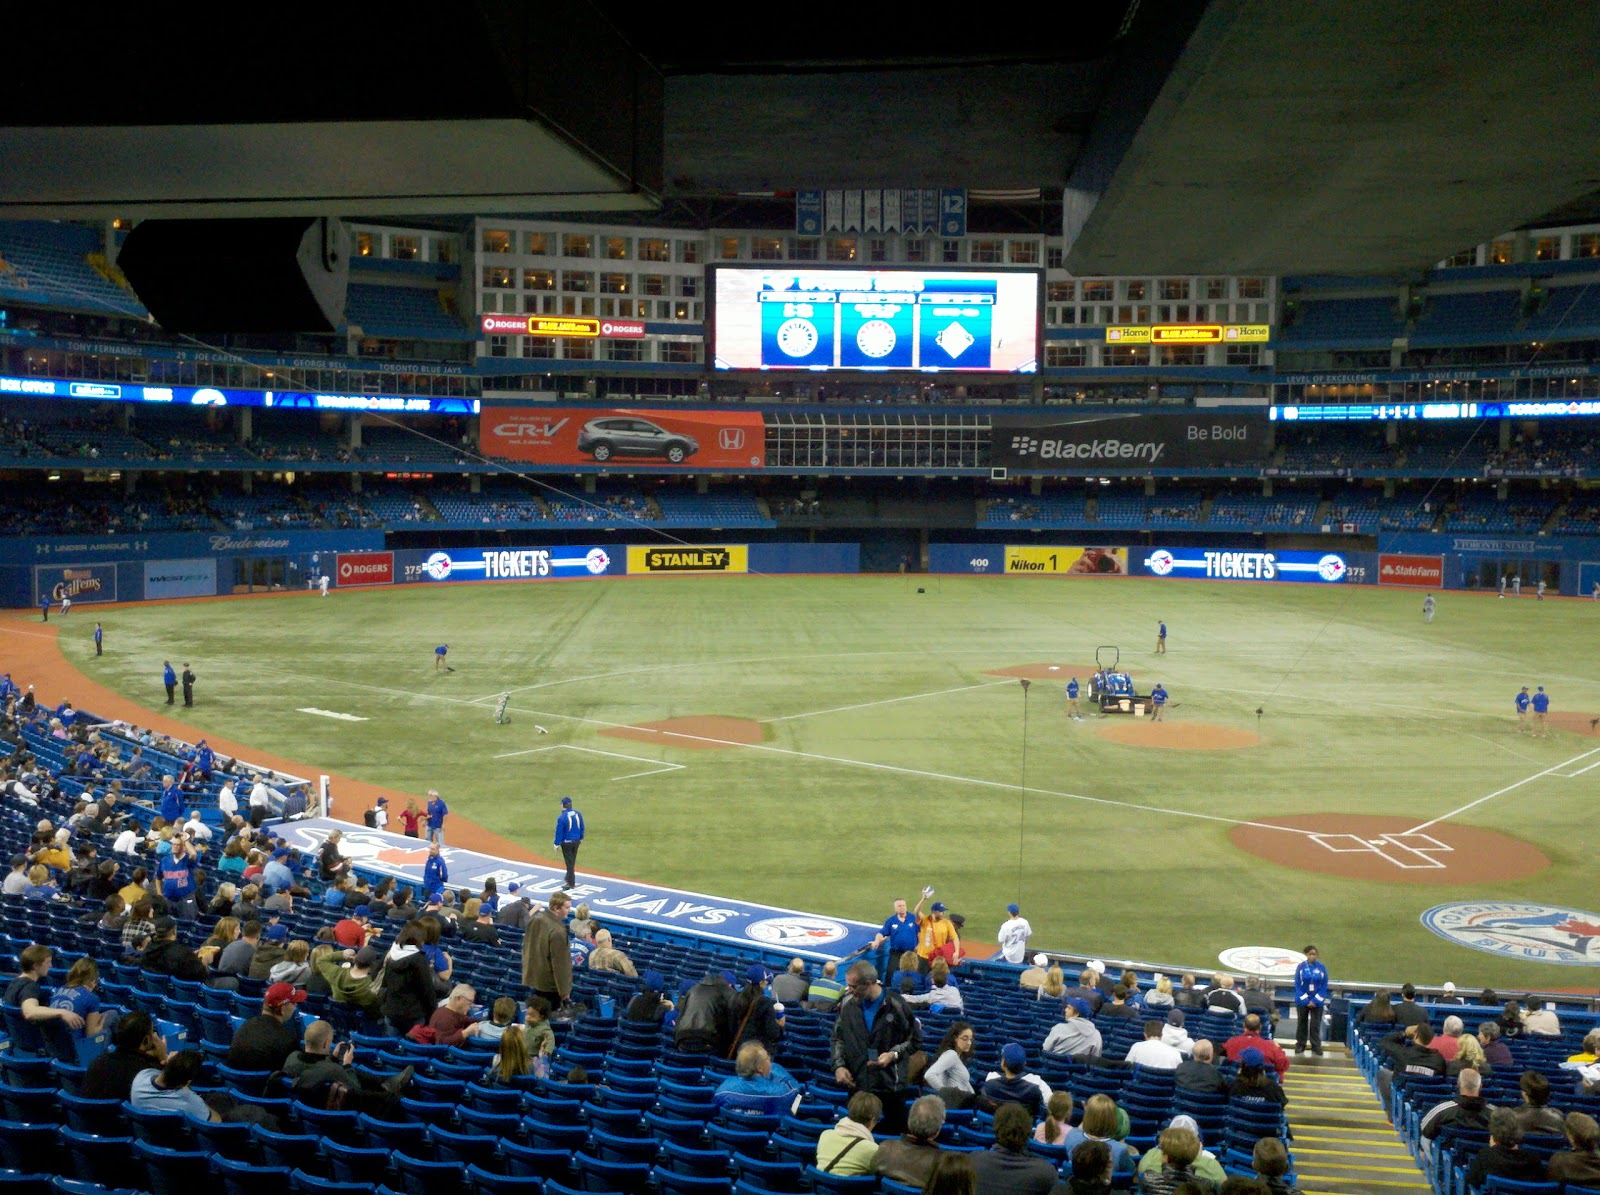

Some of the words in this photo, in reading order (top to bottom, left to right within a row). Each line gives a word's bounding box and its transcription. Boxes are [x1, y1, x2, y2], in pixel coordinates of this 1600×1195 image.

[943, 195, 964, 214] 12
[495, 321, 527, 329] ROGERS
[613, 325, 643, 333] ROGERS
[1122, 329, 1149, 337] Home
[1240, 327, 1267, 335] Home
[68, 341, 92, 351] TONY
[95, 344, 143, 355] FERNANDEZ
[176, 351, 187, 360] 29
[194, 353, 209, 362] JOE
[293, 359, 327, 368] GEORGE
[329, 361, 347, 369] BELL
[379, 363, 418, 373] TORONTO
[421, 365, 442, 374] BLUE
[443, 366, 463, 375] JAYS
[1428, 372, 1450, 380] DAVE
[1552, 366, 1590, 375] GASTON
[1286, 375, 1309, 383] LEVEL
[1326, 374, 1377, 382] EXCELLENCE
[493, 416, 571, 437] CR-V
[1187, 425, 1208, 440] Be
[1212, 425, 1247, 440] Bold
[1040, 439, 1164, 462] BlackBerry
[54, 544, 87, 552] UNDER
[89, 543, 129, 551] ARMOUR
[209, 535, 290, 551] Budweiser
[482, 550, 549, 577] TICKETS
[651, 552, 725, 566] STANLEY
[970, 558, 989, 567] 400
[1010, 560, 1045, 571] Nikon
[1049, 554, 1058, 571] 1
[353, 564, 388, 574] ROGERS
[404, 565, 422, 575] 375
[1204, 551, 1275, 579] TICKETS
[1346, 566, 1365, 576] 375
[469, 869, 607, 900] BLUE
[592, 893, 740, 924] JAYS
[1440, 906, 1544, 925] TORONTO
[1472, 938, 1580, 961] BLUE
